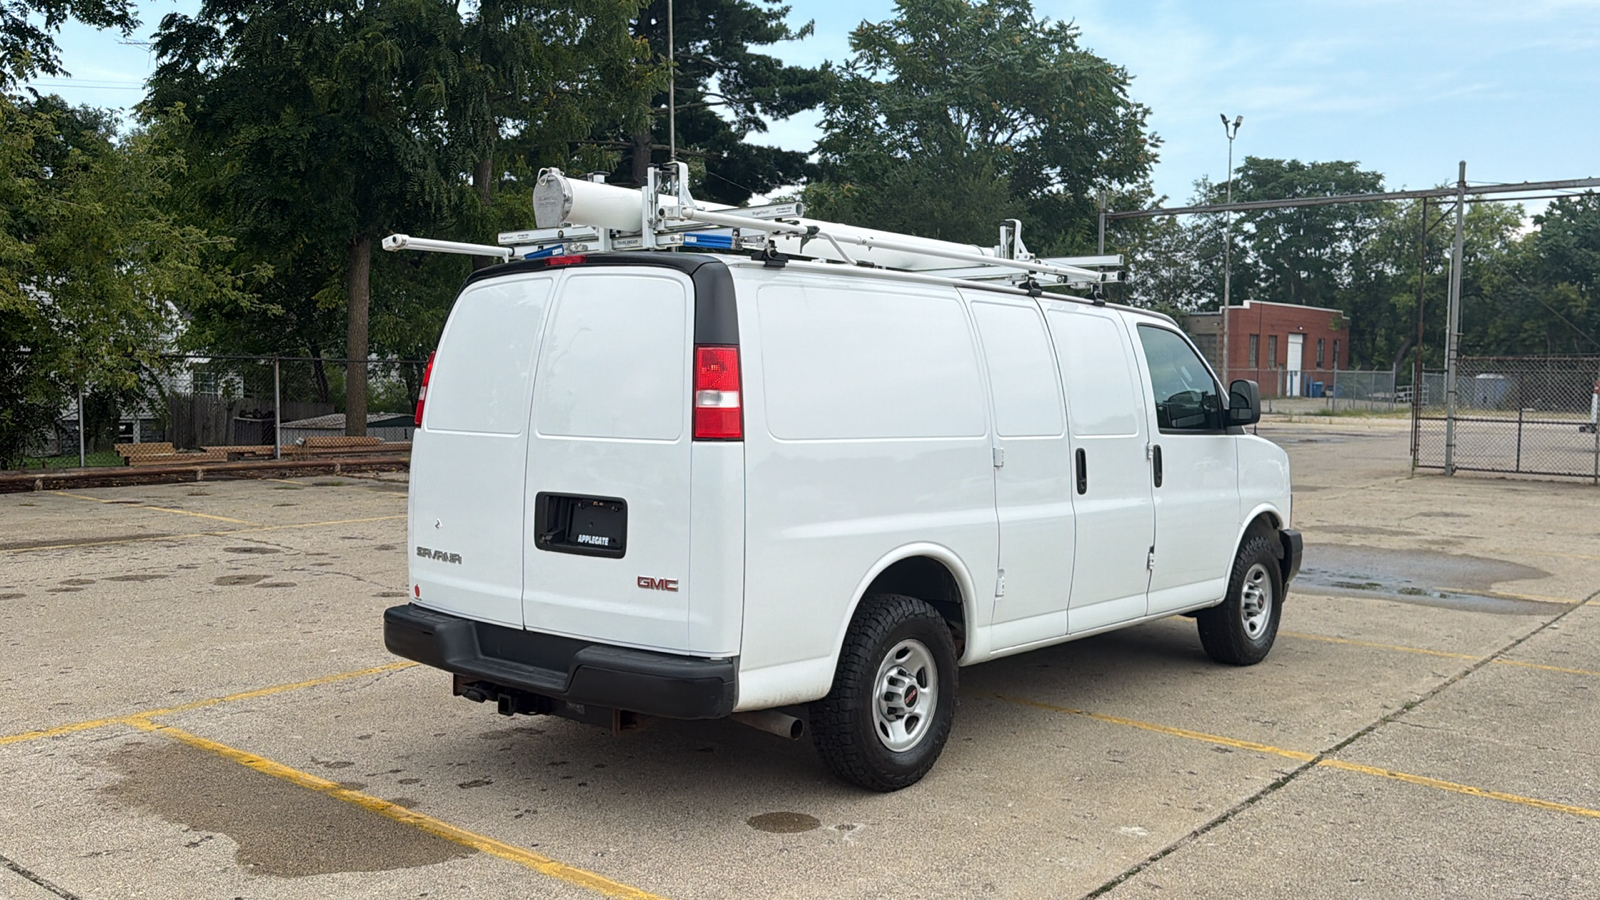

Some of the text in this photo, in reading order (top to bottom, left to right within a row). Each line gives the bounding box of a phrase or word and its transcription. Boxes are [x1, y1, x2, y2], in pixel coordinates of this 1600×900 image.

[577, 534, 610, 546] APPLEGATE
[416, 546, 462, 565] SAVANA
[637, 576, 679, 592] GMC
